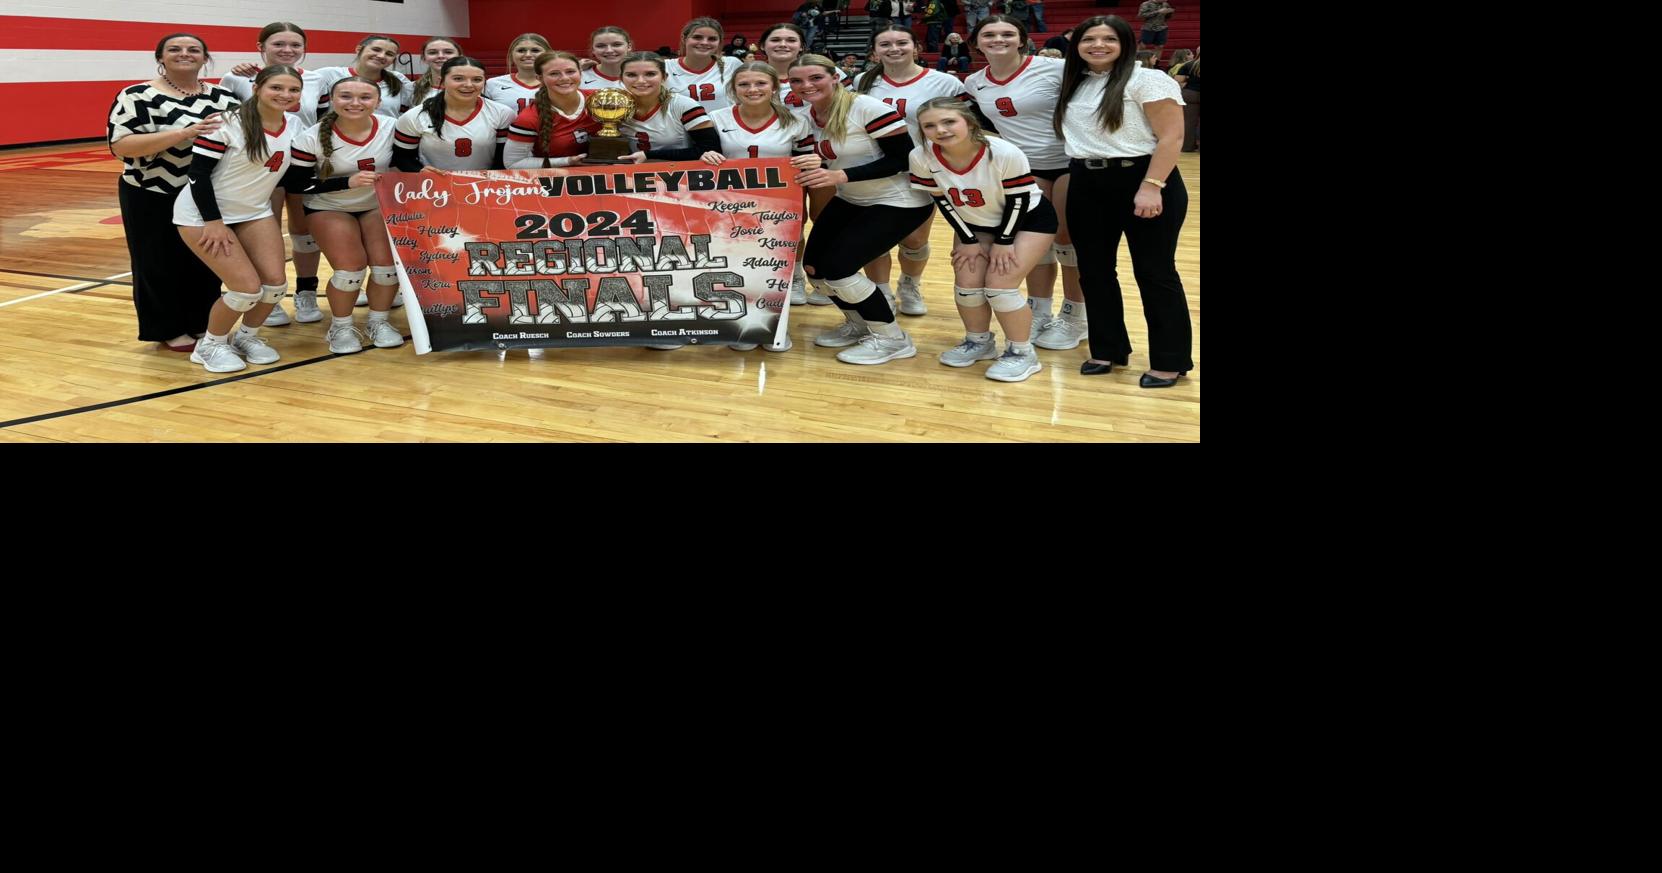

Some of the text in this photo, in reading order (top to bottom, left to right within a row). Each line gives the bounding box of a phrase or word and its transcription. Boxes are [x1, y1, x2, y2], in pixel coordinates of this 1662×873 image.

[687, 83, 716, 102] 12
[995, 97, 1018, 118] 9
[454, 137, 473, 158] 8
[747, 145, 759, 159] 1
[264, 151, 284, 173] 4
[357, 157, 376, 172] 5
[453, 179, 550, 206] Trojans
[538, 166, 788, 198] VOLLEYBALL
[947, 187, 986, 208] 13
[708, 200, 757, 214] Keegan
[417, 225, 460, 239] Hailey
[514, 209, 655, 240] 2024
[730, 225, 765, 239] Josie
[757, 237, 800, 253] Kinsey
[419, 251, 459, 265] Sydney
[463, 234, 729, 277] REGIONAL
[742, 257, 789, 272] Adalyn
[457, 271, 748, 325] FINALS
[492, 331, 550, 340] Coach Ruesch
[566, 330, 630, 339] Coach Sowders
[651, 328, 719, 337] Coach Atkinson
